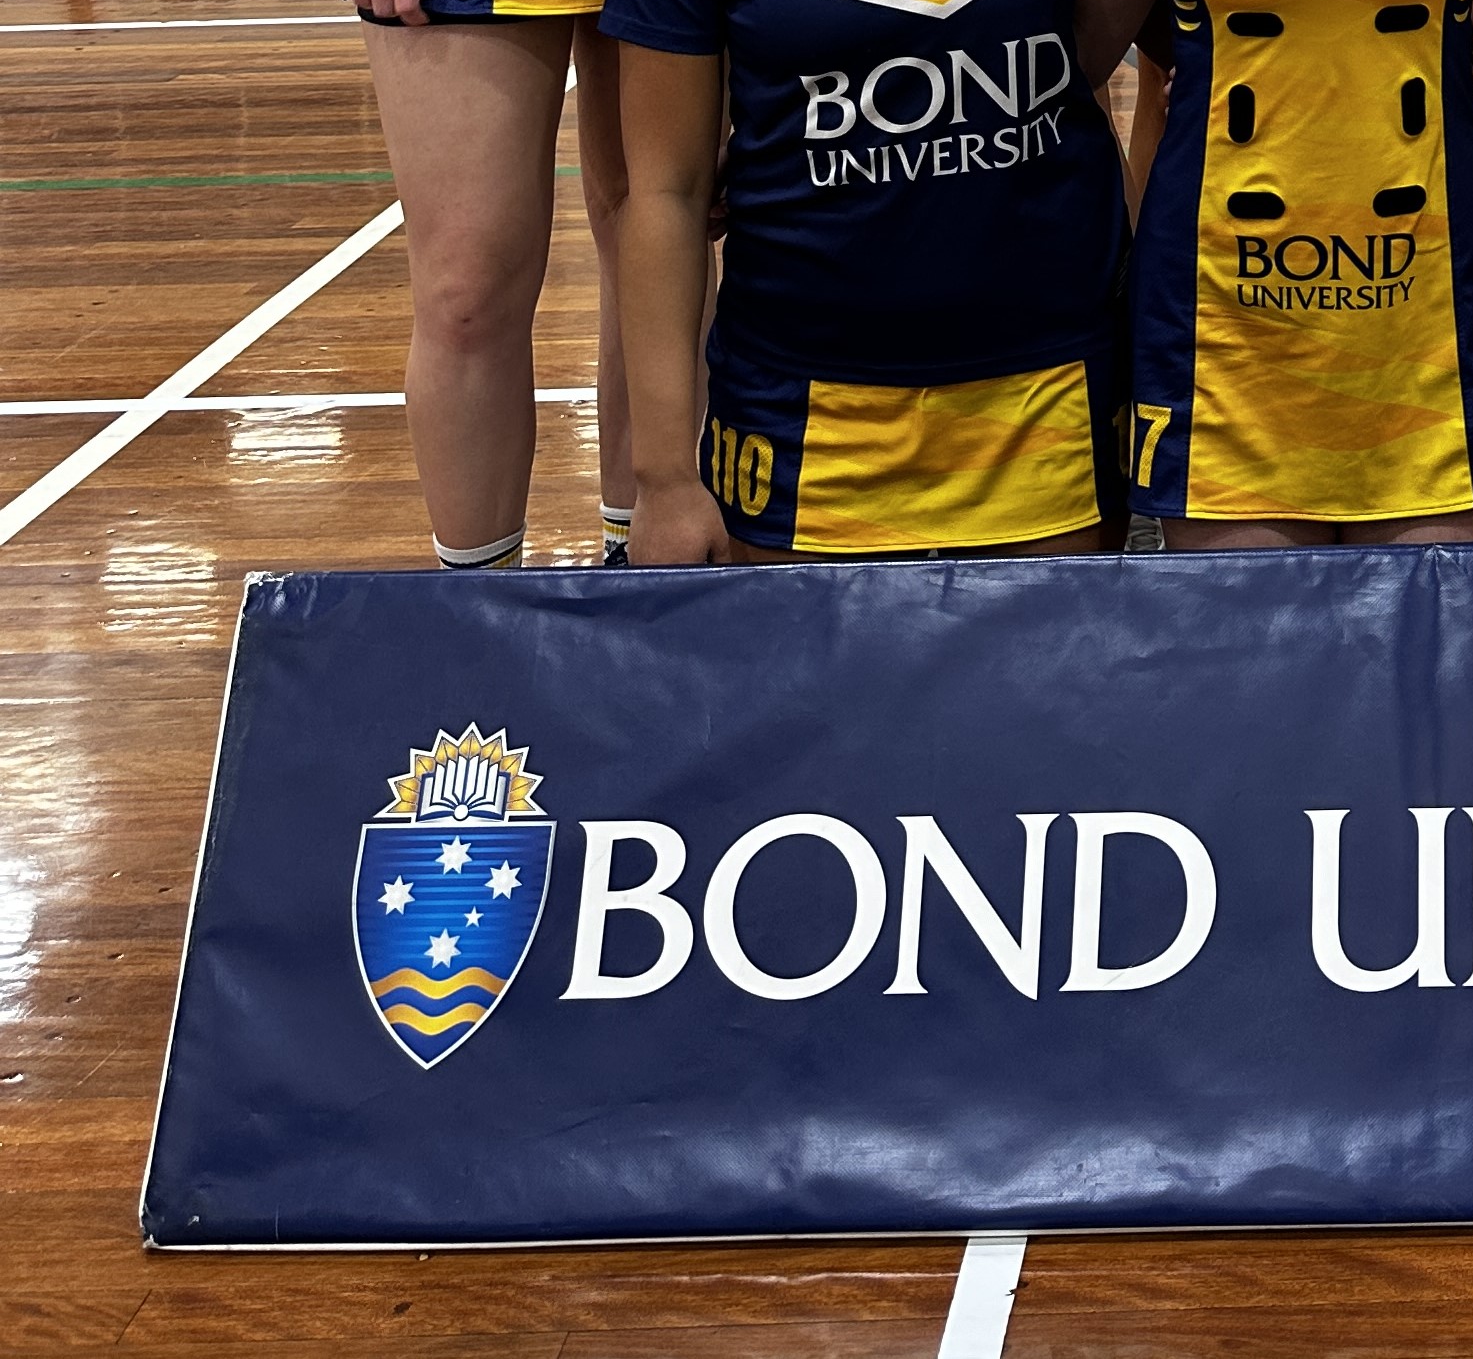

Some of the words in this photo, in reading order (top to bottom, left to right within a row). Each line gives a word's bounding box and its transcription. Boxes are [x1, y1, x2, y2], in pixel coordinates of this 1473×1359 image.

[799, 32, 1071, 140] BOND
[806, 106, 1065, 187] UNIVERSITY
[1235, 233, 1416, 282] BOND
[1236, 276, 1416, 311] UNIVERSITY
[558, 811, 1218, 1001] BOND
